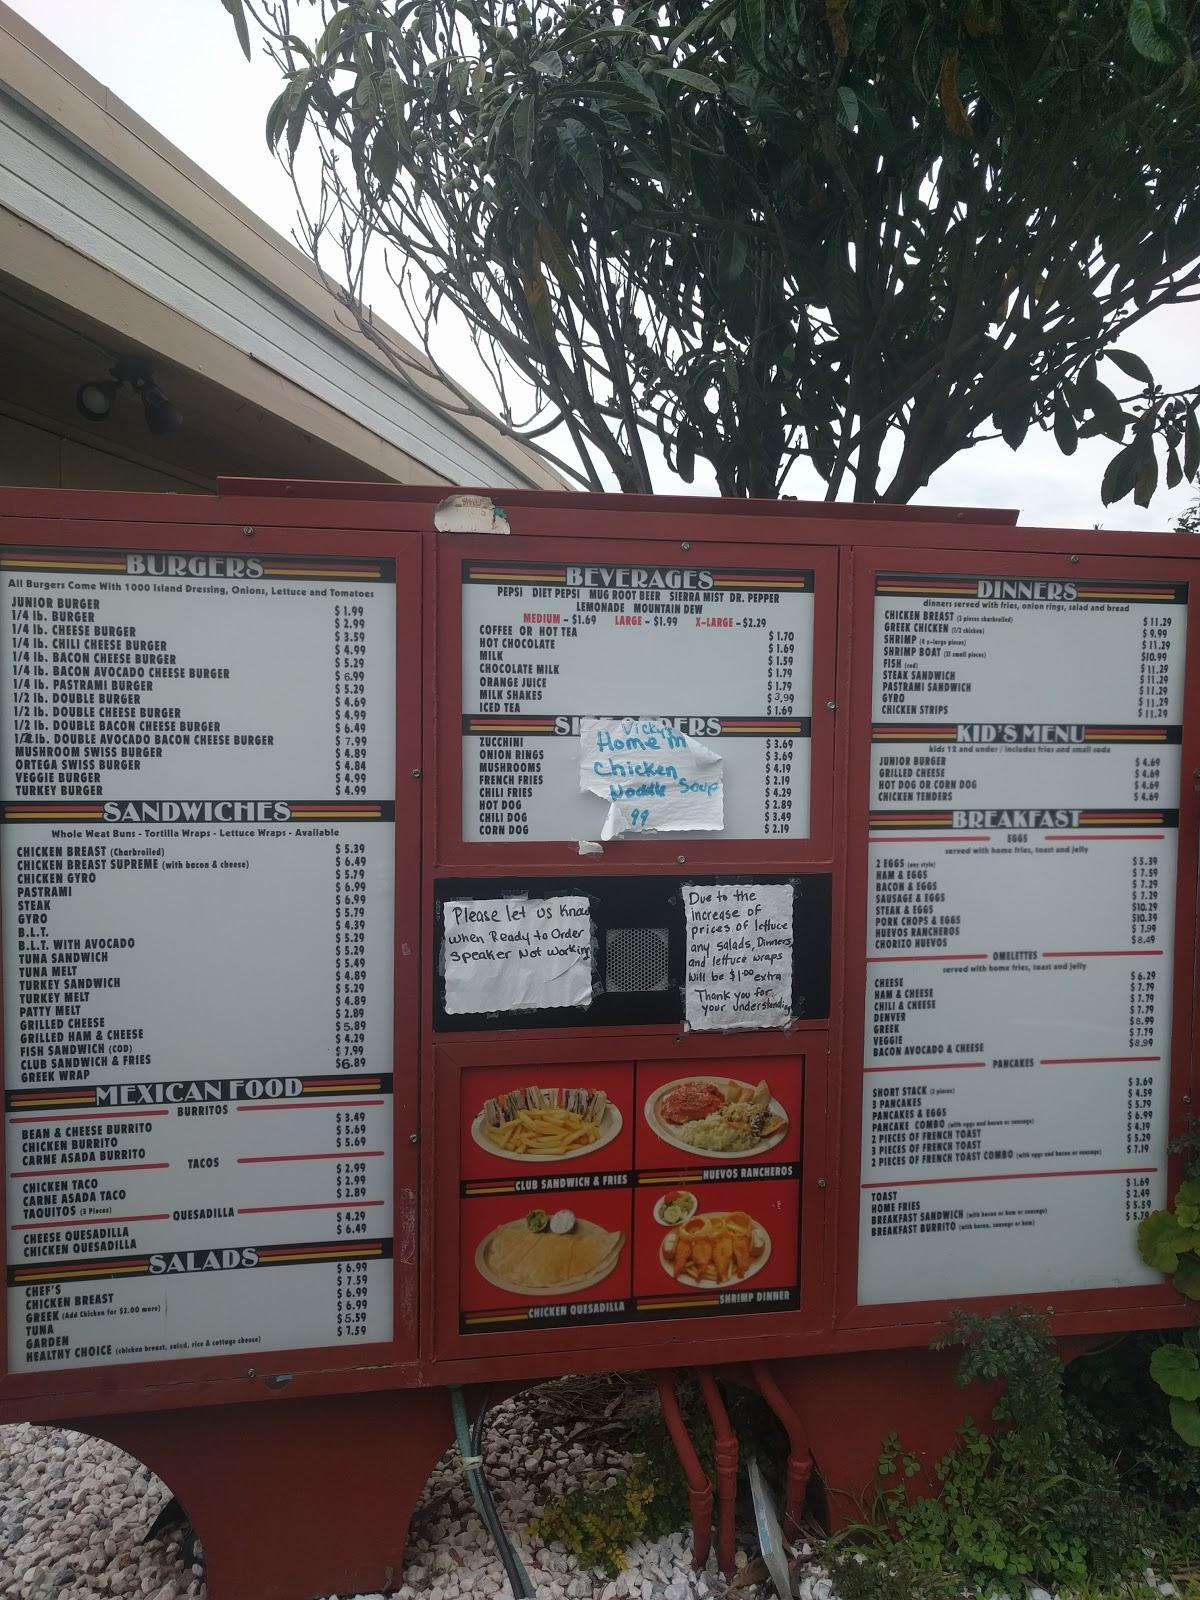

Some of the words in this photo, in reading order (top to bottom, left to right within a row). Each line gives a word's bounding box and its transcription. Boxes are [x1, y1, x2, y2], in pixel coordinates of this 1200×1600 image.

[126, 553, 264, 578] BURGERS
[566, 566, 714, 589] BEVERAGES
[8, 579, 23, 587] All
[26, 579, 65, 590] Burgers
[68, 581, 96, 590] Come
[100, 582, 122, 591] With
[125, 583, 150, 592] 1000
[153, 584, 182, 593] Island
[185, 585, 228, 595] Dressing,
[231, 586, 268, 596] Onions,
[272, 587, 308, 597] Lettuce
[309, 588, 327, 597] and
[330, 589, 374, 598] Tomatoes
[977, 581, 1078, 600] DINNERS
[498, 587, 523, 598] PEPSI
[532, 588, 551, 598] DIET
[555, 588, 580, 599] PEPSI
[589, 588, 609, 599] MUG
[612, 589, 636, 600] ROOT
[639, 590, 661, 601] BEER
[670, 590, 701, 602] SIERRA
[703, 591, 724, 602] MIST
[730, 592, 745, 602] DR.
[748, 592, 779, 604] PEPPER
[12, 597, 53, 608] JUNIOR
[58, 598, 100, 610] BURGER
[576, 602, 625, 613] LEMONADE
[634, 603, 681, 614] MOUNTAIN
[684, 604, 703, 615] DEW
[12, 610, 29, 621] 1/4
[52, 611, 94, 622] BURGER
[523, 613, 560, 624] MEDIUM
[615, 616, 642, 626] LARGE
[884, 610, 920, 621] CHICKEN
[923, 611, 954, 621] BREAST
[53, 638, 80, 650] CHILI
[84, 640, 122, 651] CHEESE
[125, 640, 167, 651] BURGER
[480, 638, 499, 648] HOT
[502, 638, 555, 649] CHOCOLATE
[884, 635, 916, 644] SHRIMP
[883, 670, 908, 680] STEAK
[911, 671, 955, 681] SANDWICH
[53, 680, 108, 691] PASTRAMI
[111, 681, 153, 692] BURGER
[480, 677, 518, 688] ORANGE
[521, 678, 547, 688] JUICE
[480, 702, 500, 712] ICED
[503, 702, 520, 713] TEA
[882, 705, 916, 715] CHICKEN
[919, 705, 948, 715] STRIPS
[957, 725, 1016, 743] KID'S
[1023, 726, 1085, 743] MENU
[480, 737, 523, 748] ZUCCHINI
[597, 731, 660, 752] Home
[15, 746, 80, 758] MUSHROOM
[84, 747, 118, 758] SWISS
[121, 747, 162, 758] BURGER
[480, 749, 511, 760] ONION
[516, 750, 544, 760] RINGS
[15, 759, 58, 771] ORTEGA
[61, 759, 95, 771] SWISS
[479, 762, 541, 772] MUSHROOMS
[15, 772, 55, 784] VEGGIE
[16, 785, 57, 796] TURKEY
[679, 778, 718, 796] Soup
[102, 801, 291, 821] SANDWICHES
[952, 810, 1082, 829] BREAKFAST
[52, 829, 83, 839] Whole
[85, 829, 111, 838] Weat
[114, 829, 135, 838] Buns
[145, 829, 178, 837] Tortilla
[181, 829, 210, 839] Wraps
[220, 828, 255, 837] Lettuce
[258, 828, 286, 838] Wraps
[295, 828, 339, 837] Available
[479, 824, 505, 835] CORN
[508, 824, 529, 835] DOG
[1007, 833, 1028, 843] EGGS
[17, 846, 63, 858] CHICKEN
[67, 846, 106, 857] BREAST
[17, 886, 71, 898] PASTRAMI
[689, 892, 712, 905] Due
[717, 891, 727, 902] to
[733, 889, 756, 901] the
[452, 907, 500, 925] Please
[506, 905, 526, 921] let
[692, 908, 740, 921] increase
[748, 904, 762, 916] of
[18, 913, 47, 925] GYRO
[692, 924, 730, 940] prices
[736, 920, 748, 931] of
[755, 919, 788, 932] lettuce
[489, 930, 530, 945] Ready
[534, 930, 548, 940] to
[551, 929, 584, 939] Order
[519, 947, 542, 959] Not
[691, 943, 710, 958] any
[993, 950, 1038, 961] OMELETTES
[19, 953, 48, 965] TUNA
[52, 951, 108, 963] SANDWICH
[689, 956, 706, 968] and
[713, 954, 746, 966] lettuce
[753, 953, 782, 965] wraps
[712, 971, 724, 981] be
[754, 971, 781, 981] extra
[694, 989, 730, 1002] Thank
[734, 991, 750, 1004] you
[754, 987, 773, 997] for
[20, 1006, 52, 1017] PATTY
[55, 1005, 80, 1016] MELT
[874, 1012, 906, 1023] DENVER
[874, 1024, 899, 1034] GREEK
[993, 1058, 1034, 1069] PANCAKES
[21, 1070, 55, 1083] GREEK
[59, 1070, 90, 1081] WRAP
[96, 1082, 222, 1106] MEXICAN
[229, 1079, 303, 1100] FOOD
[177, 1105, 228, 1117] BURRITOS
[22, 1139, 68, 1153] CHICKEN
[72, 1137, 118, 1150] BURRITO
[188, 1157, 219, 1169] TACOS
[703, 1168, 738, 1180] HUEVOS
[741, 1166, 792, 1178] RANCHEROS
[515, 1180, 538, 1191] CLUB
[541, 1177, 590, 1189] SANDWICH
[603, 1174, 628, 1186] FRIES
[872, 1191, 897, 1202] TOAST
[871, 1202, 896, 1213] HOME
[898, 1201, 920, 1212] FRIES
[173, 1207, 234, 1222] QUESADILLA
[149, 1249, 259, 1274] SALADS
[26, 1286, 61, 1298] CHEF'S
[719, 1292, 753, 1304] SHRIMP
[757, 1290, 790, 1302] DINNER
[529, 1306, 566, 1319] CHICKEN
[569, 1301, 625, 1316] QUESADILLA
[26, 1336, 69, 1350] GARDEN
[26, 1348, 70, 1363] HEALTHY
[74, 1345, 112, 1358] CHOICE
